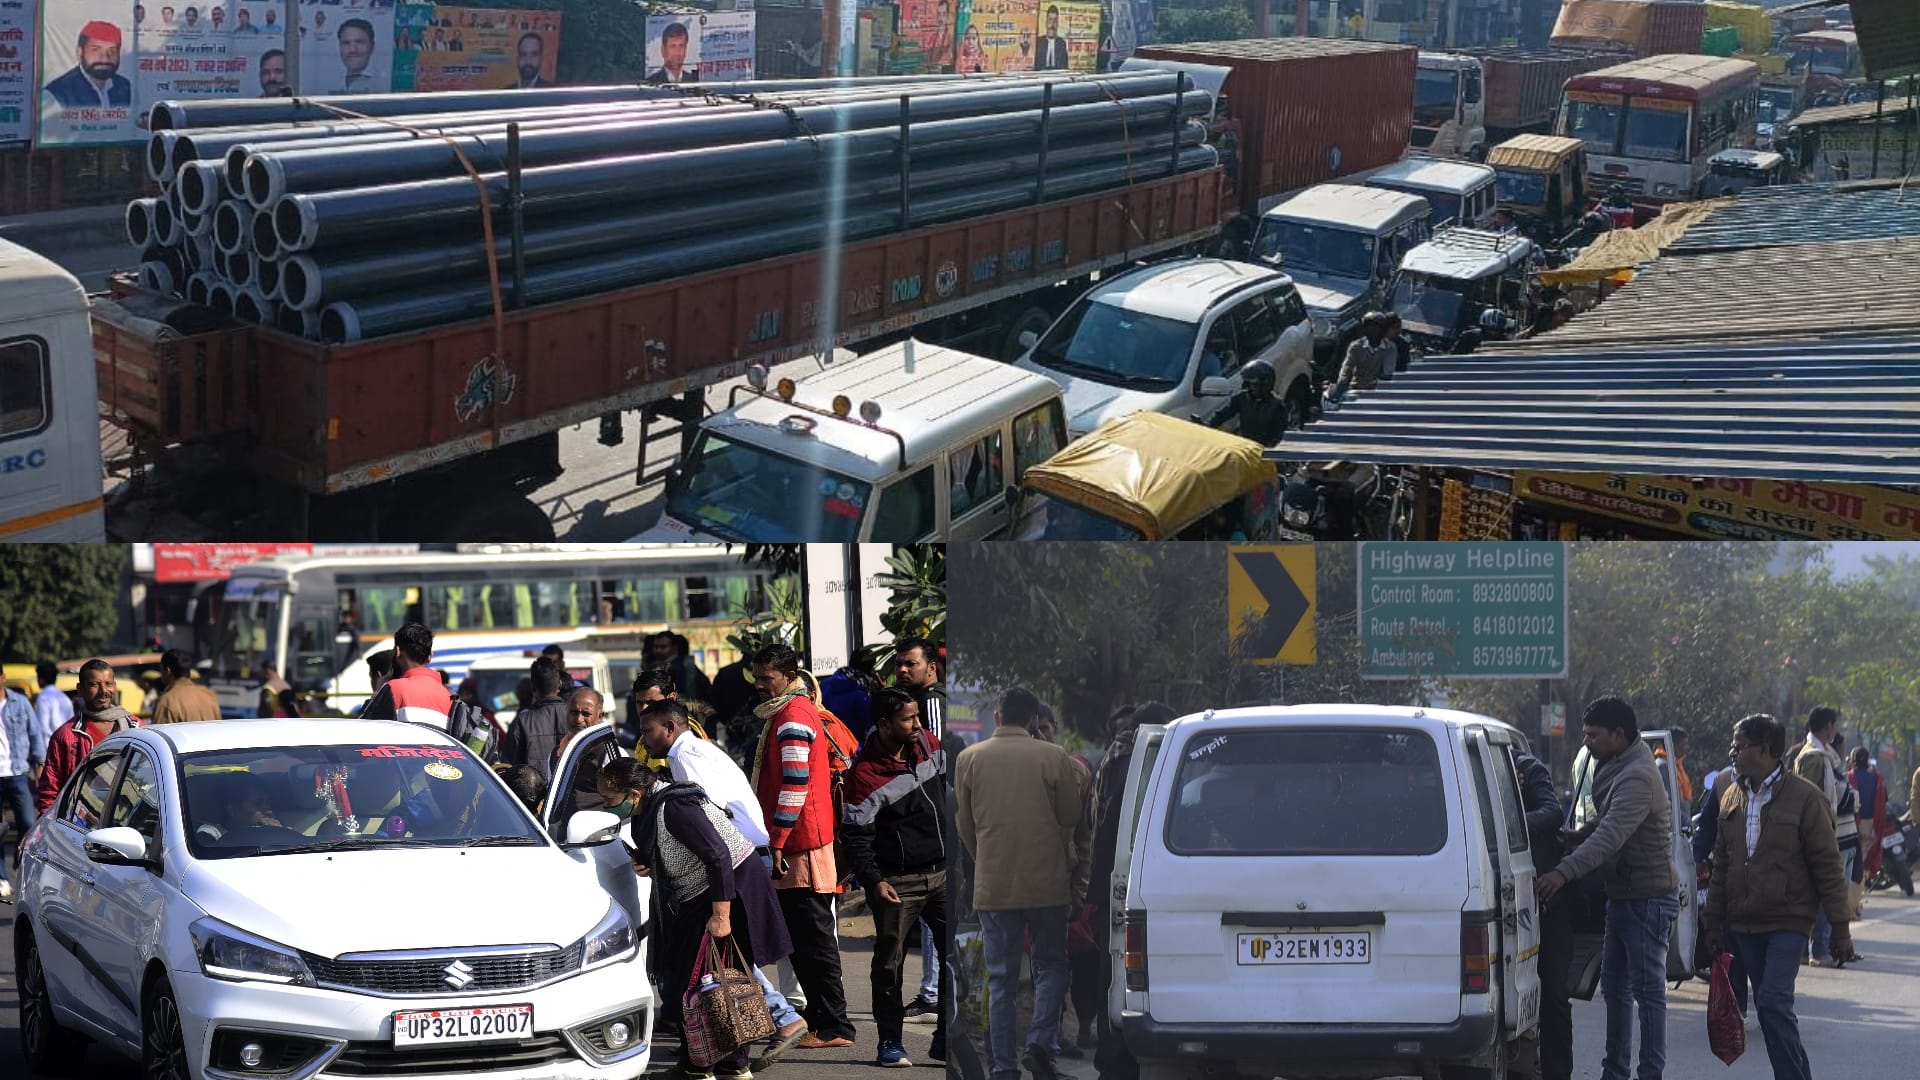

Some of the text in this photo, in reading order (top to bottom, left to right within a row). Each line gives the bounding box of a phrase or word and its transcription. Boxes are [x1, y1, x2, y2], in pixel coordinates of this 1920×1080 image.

[1370, 548, 1555, 573] Highway Helpline
[1371, 583, 1416, 604] Control
[1473, 583, 1554, 604] 8932800800
[1371, 616, 1404, 637] Route
[1473, 615, 1555, 637] 8418012012
[1371, 646, 1555, 667] Ambulance 8573967777
[1250, 937, 1368, 961] UP32EN1933
[408, 1012, 530, 1039] UP32LQ2007
